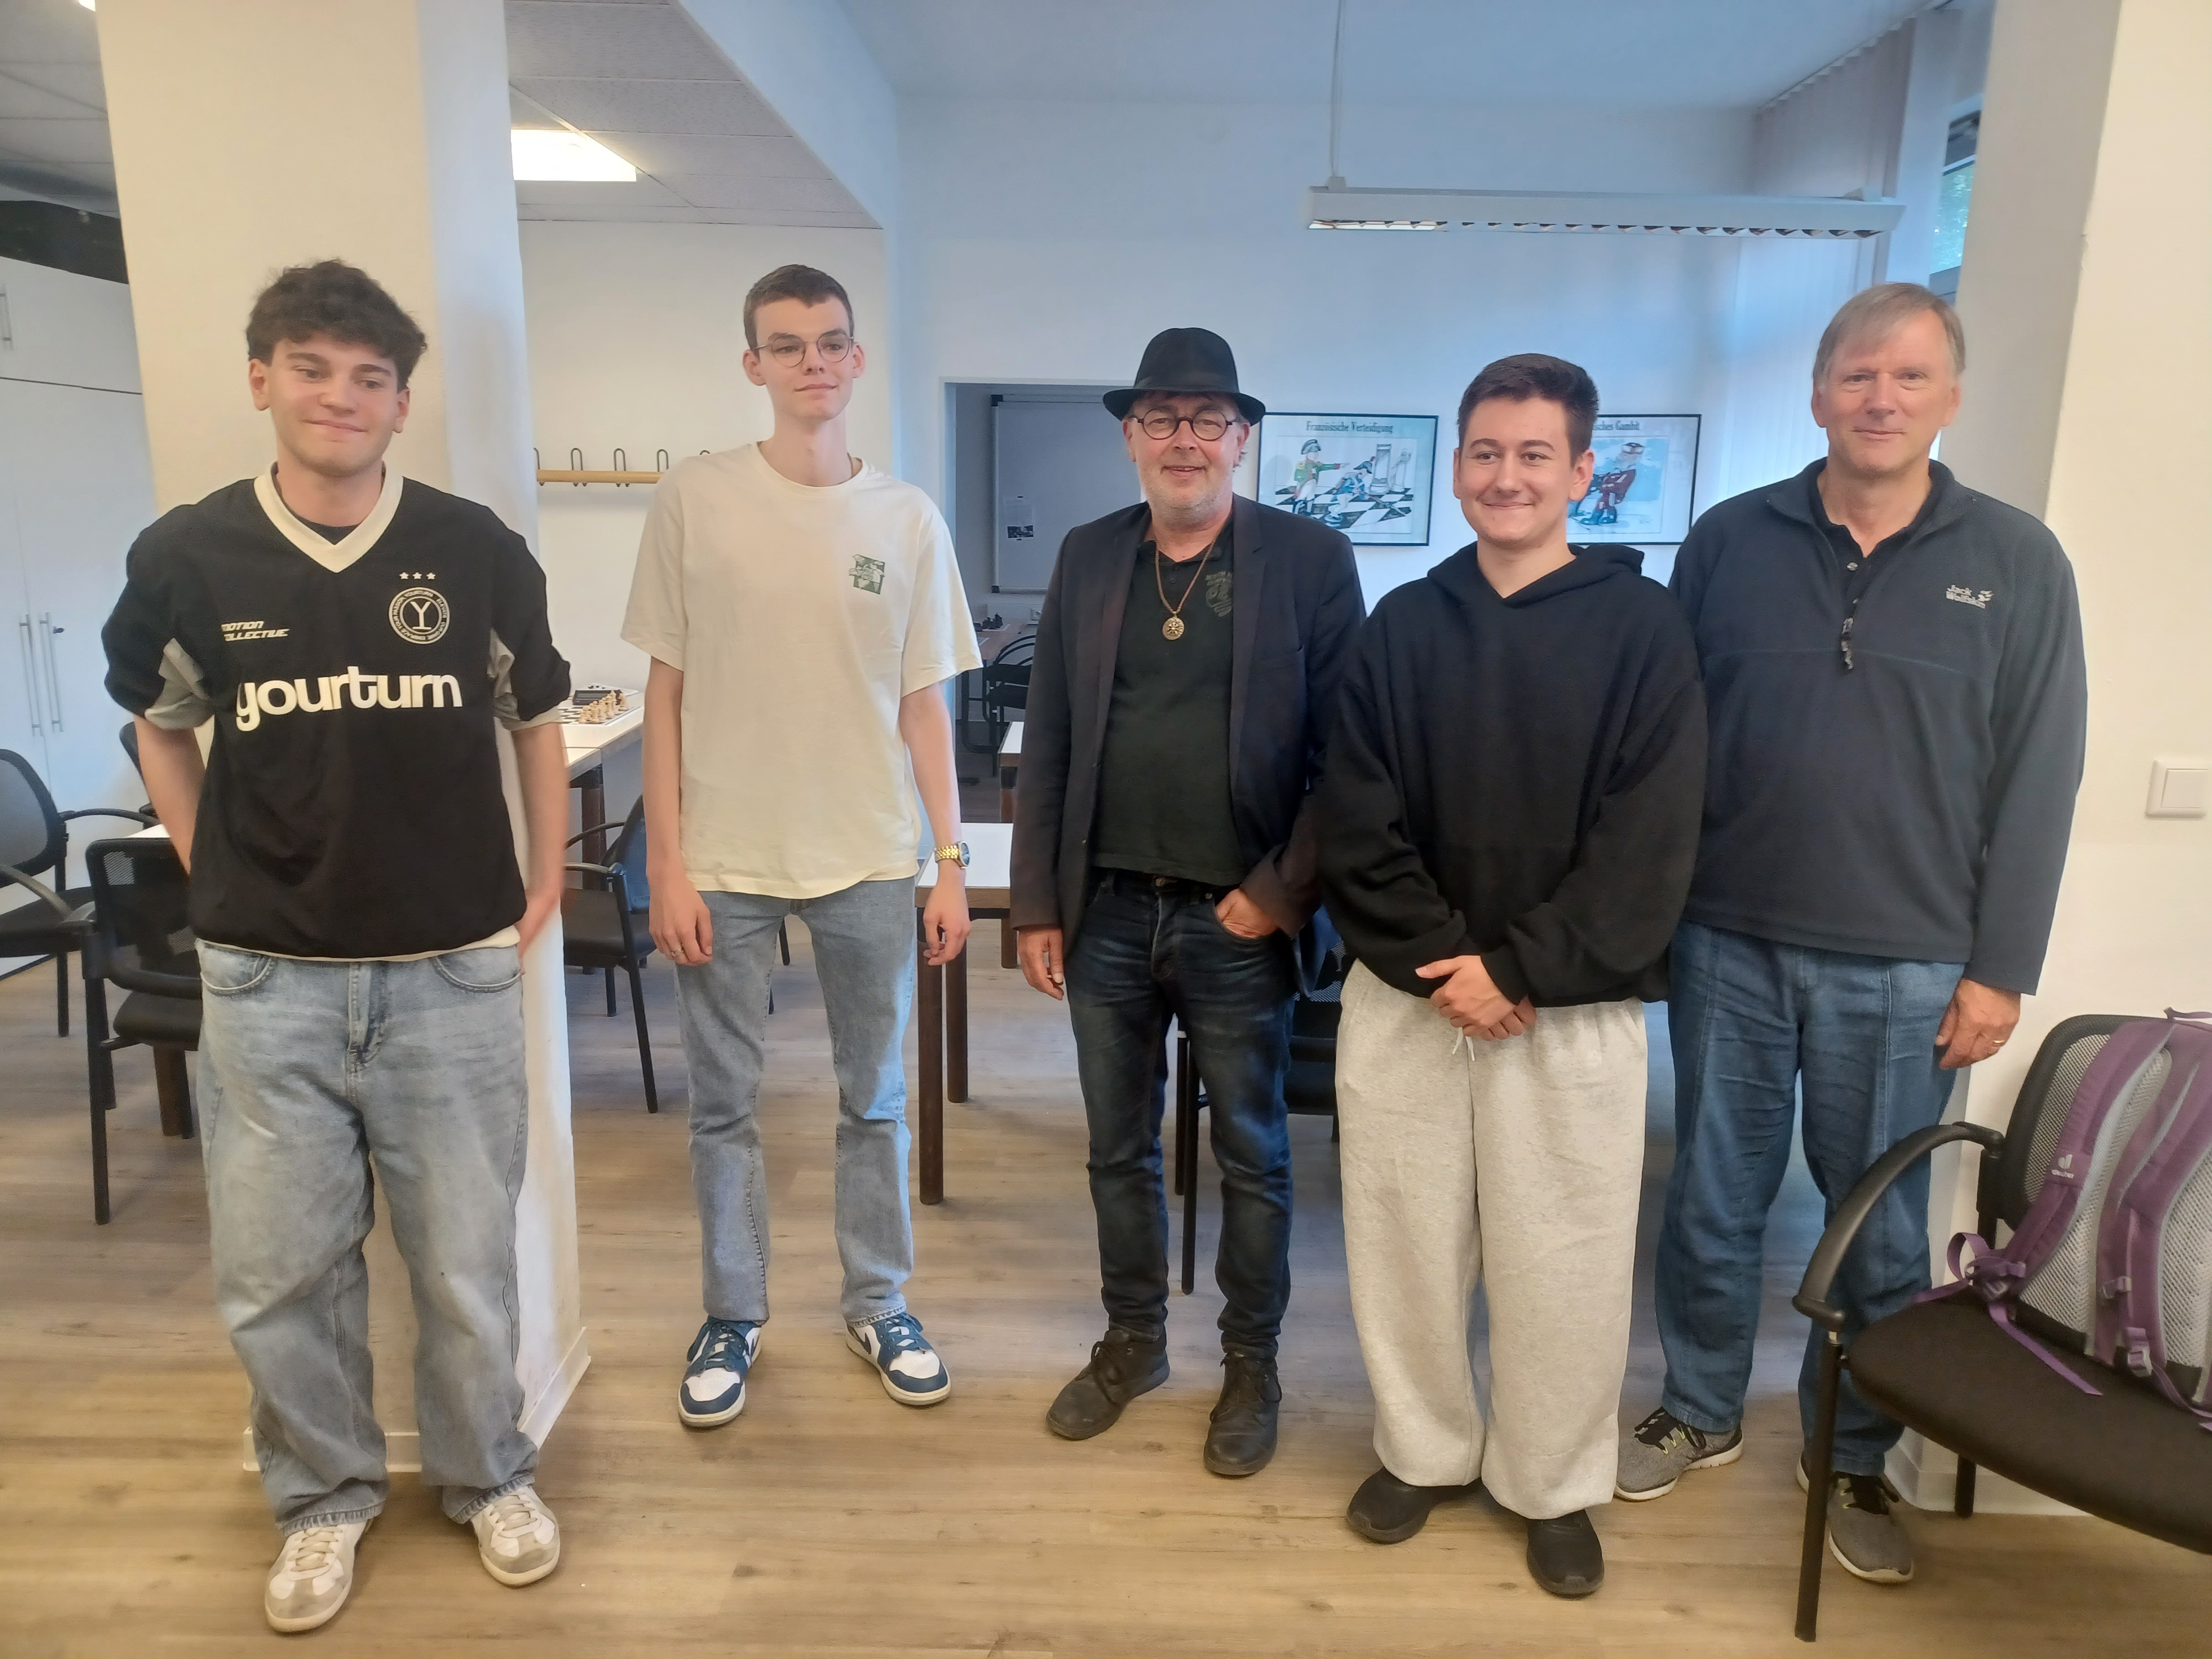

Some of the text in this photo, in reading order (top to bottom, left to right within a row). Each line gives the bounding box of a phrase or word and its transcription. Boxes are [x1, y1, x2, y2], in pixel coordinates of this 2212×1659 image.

[221, 620, 264, 632] OTION
[410, 601, 432, 630] Y
[236, 665, 463, 732] yourturn
